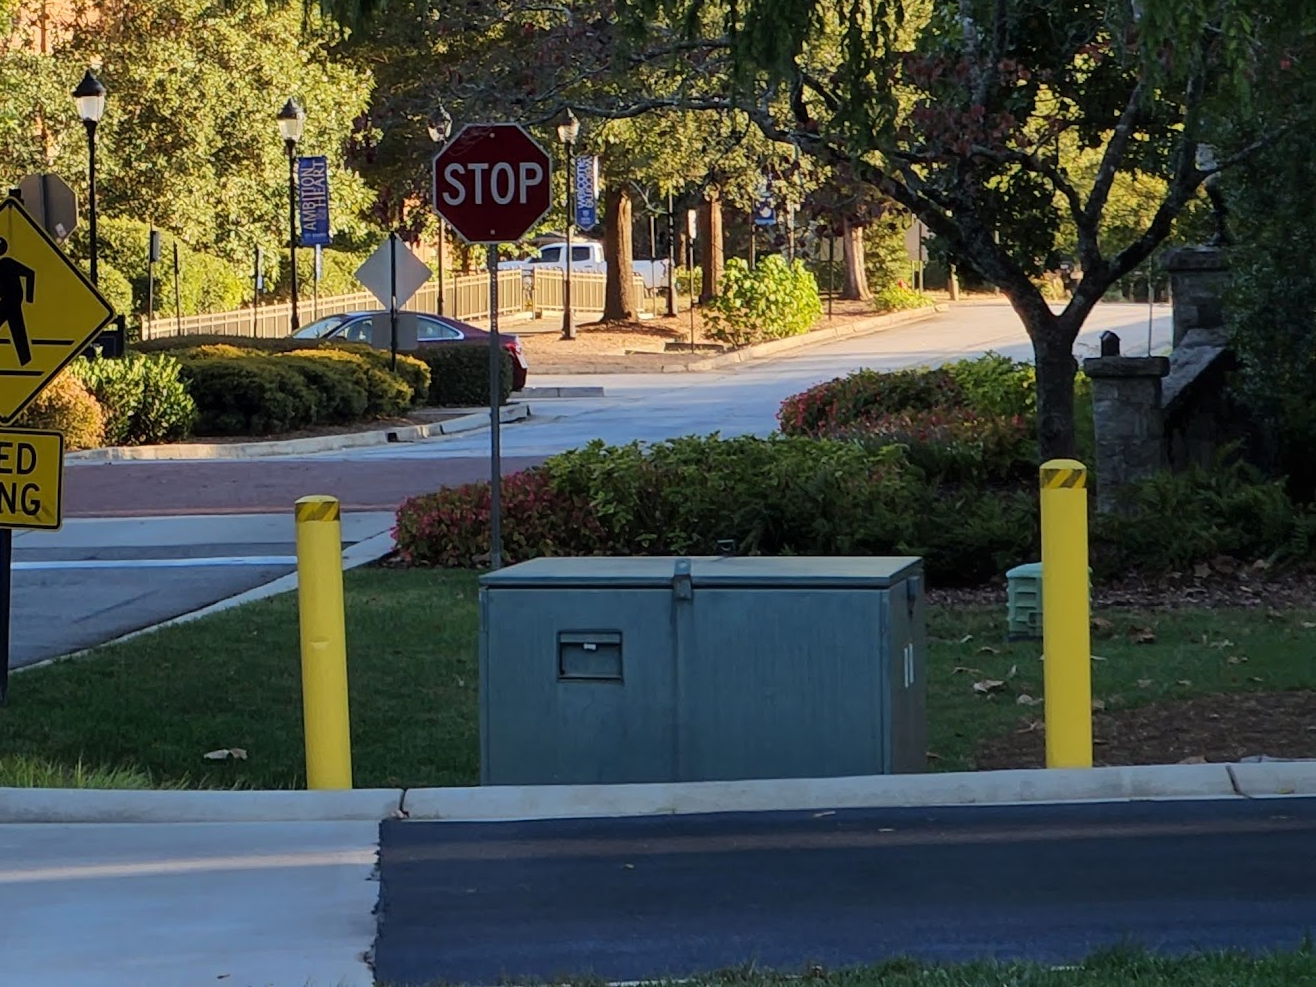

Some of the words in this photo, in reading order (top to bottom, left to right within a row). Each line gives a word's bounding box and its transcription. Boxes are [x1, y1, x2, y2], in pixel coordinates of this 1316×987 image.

[300, 167, 317, 230] AMBITION
[314, 160, 326, 207] HEART
[442, 162, 544, 206] STOP
[577, 157, 586, 209] welcome
